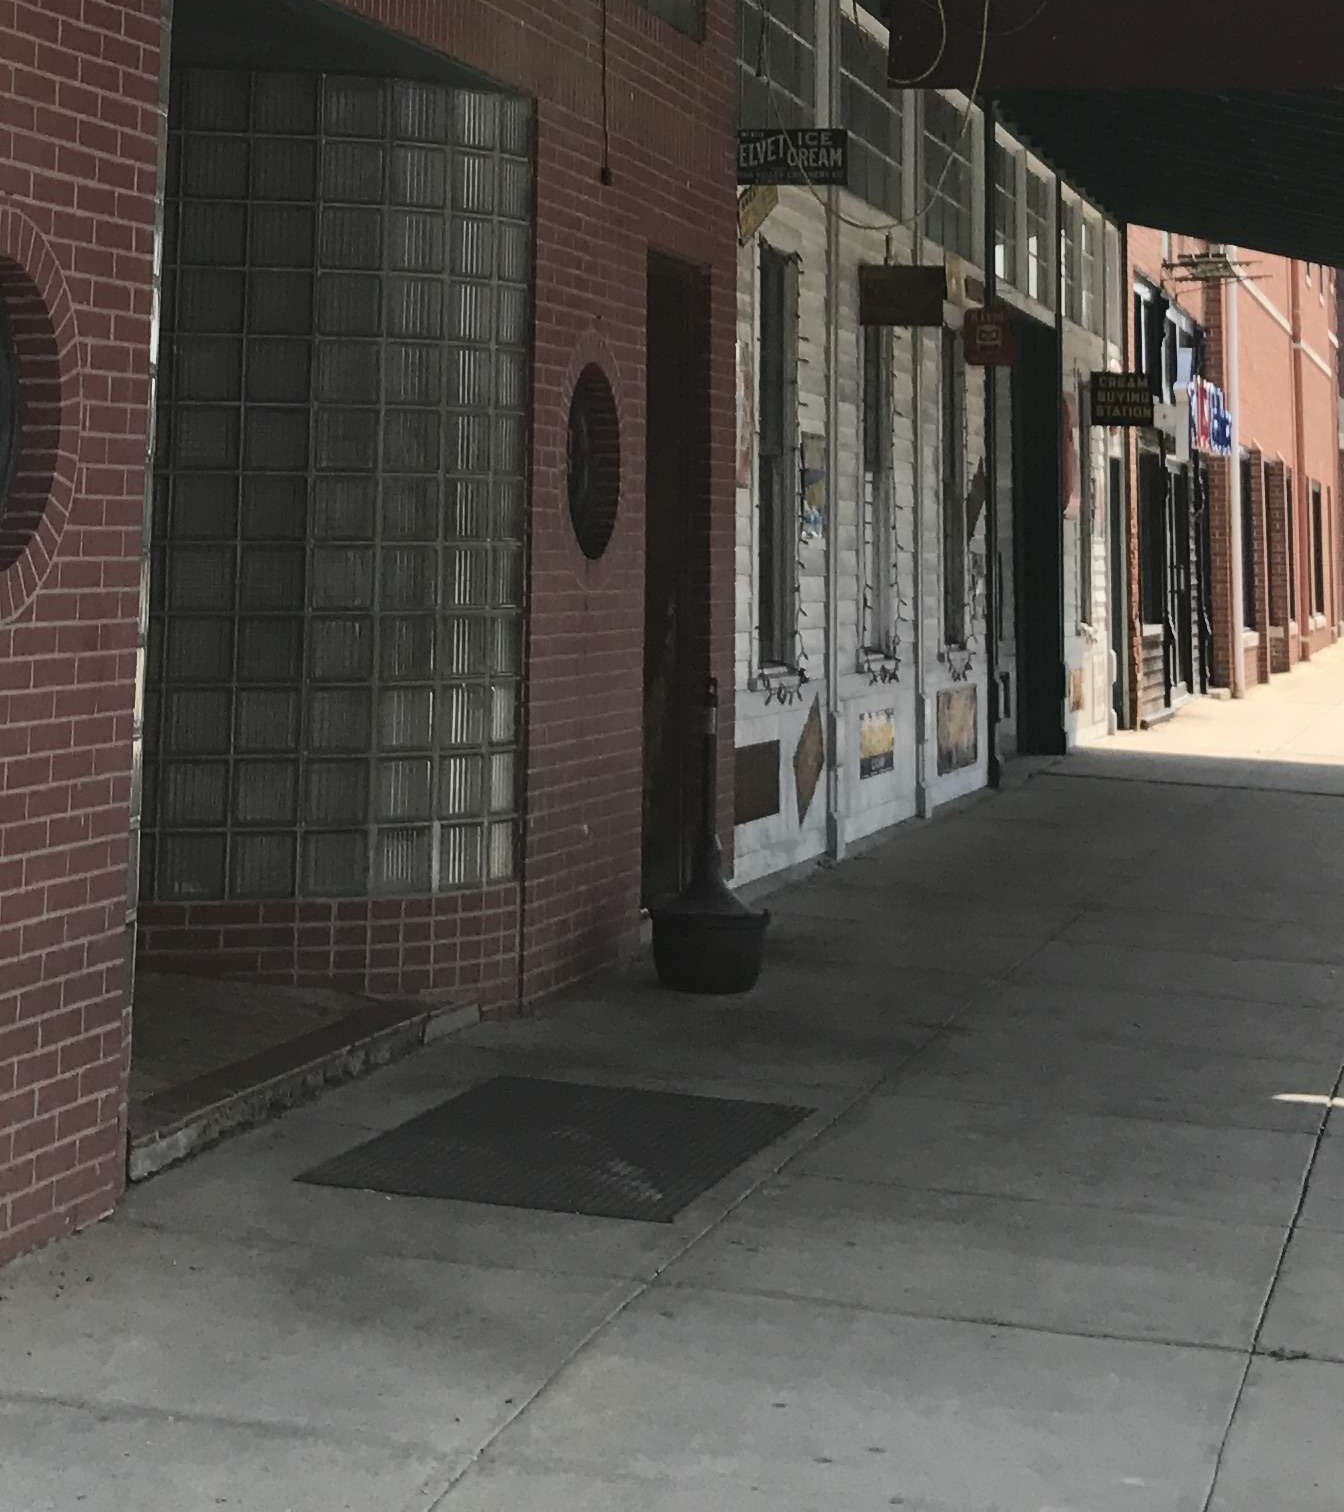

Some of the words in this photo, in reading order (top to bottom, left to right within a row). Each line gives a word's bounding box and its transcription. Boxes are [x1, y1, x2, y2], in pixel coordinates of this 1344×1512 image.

[797, 131, 833, 146] ICE
[737, 134, 785, 167] ELVET
[787, 147, 843, 168] CREAM
[1098, 376, 1148, 388] CREAM
[1095, 404, 1153, 418] STATION
